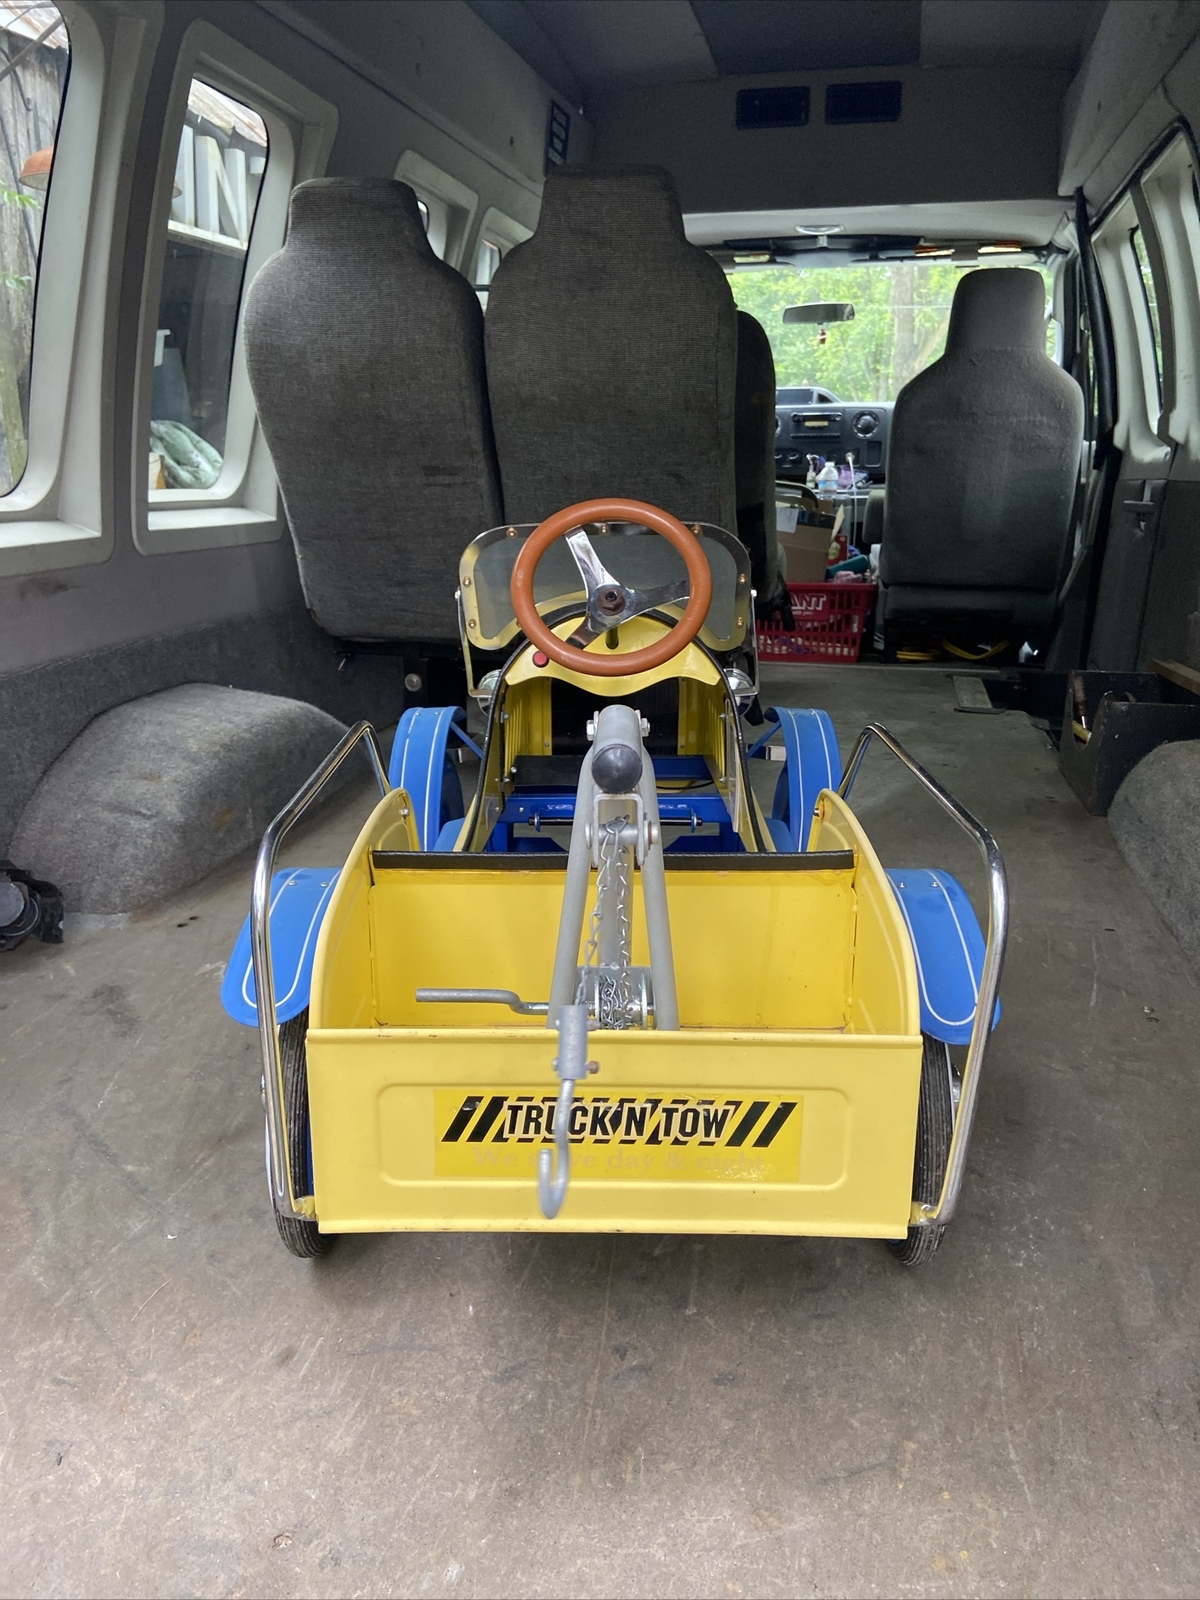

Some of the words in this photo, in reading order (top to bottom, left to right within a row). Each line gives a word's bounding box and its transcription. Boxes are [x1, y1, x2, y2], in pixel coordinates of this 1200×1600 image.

[661, 1107, 731, 1139] TOW
[471, 1147, 518, 1168] We
[529, 1153, 596, 1168] sve
[606, 1148, 655, 1177] day
[664, 1150, 685, 1170] &
[696, 1150, 764, 1177] night
